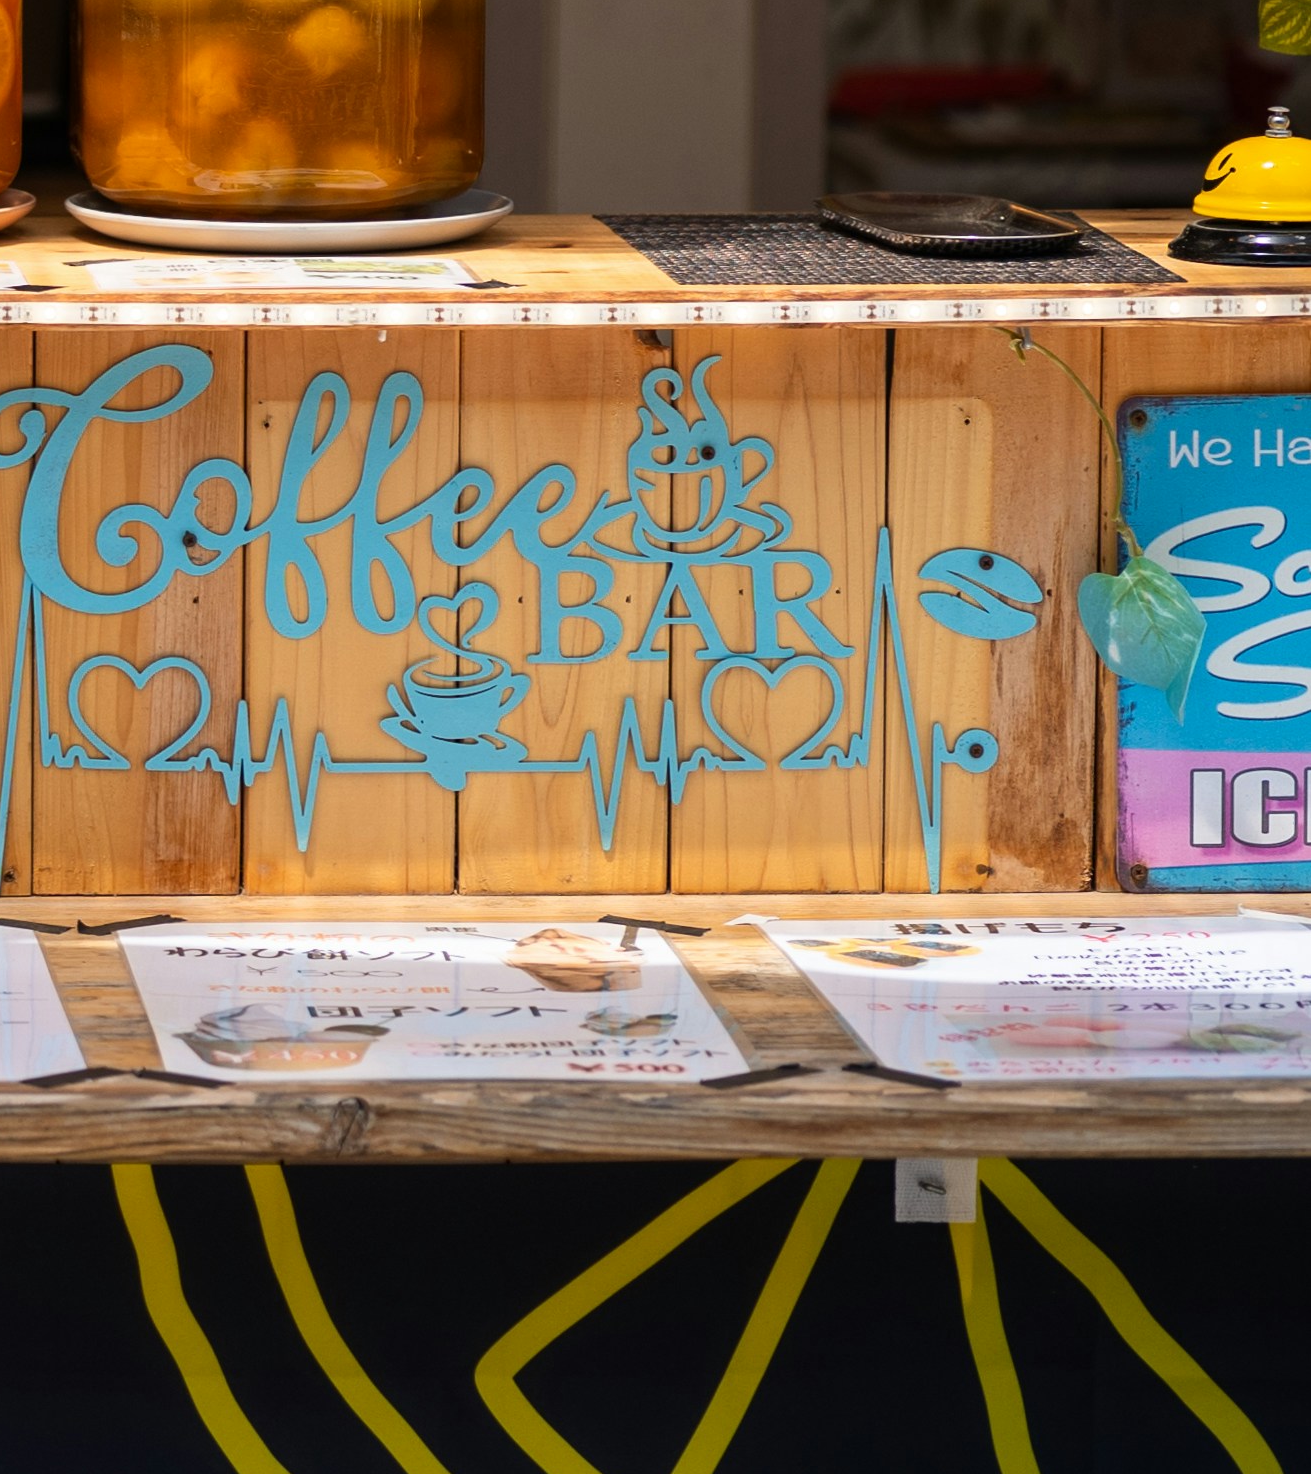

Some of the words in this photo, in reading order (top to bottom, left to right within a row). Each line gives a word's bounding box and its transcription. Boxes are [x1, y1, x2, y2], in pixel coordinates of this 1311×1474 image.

[1170, 431, 1232, 468] We
[529, 548, 854, 664] BAR
[1191, 768, 1311, 848] IC
